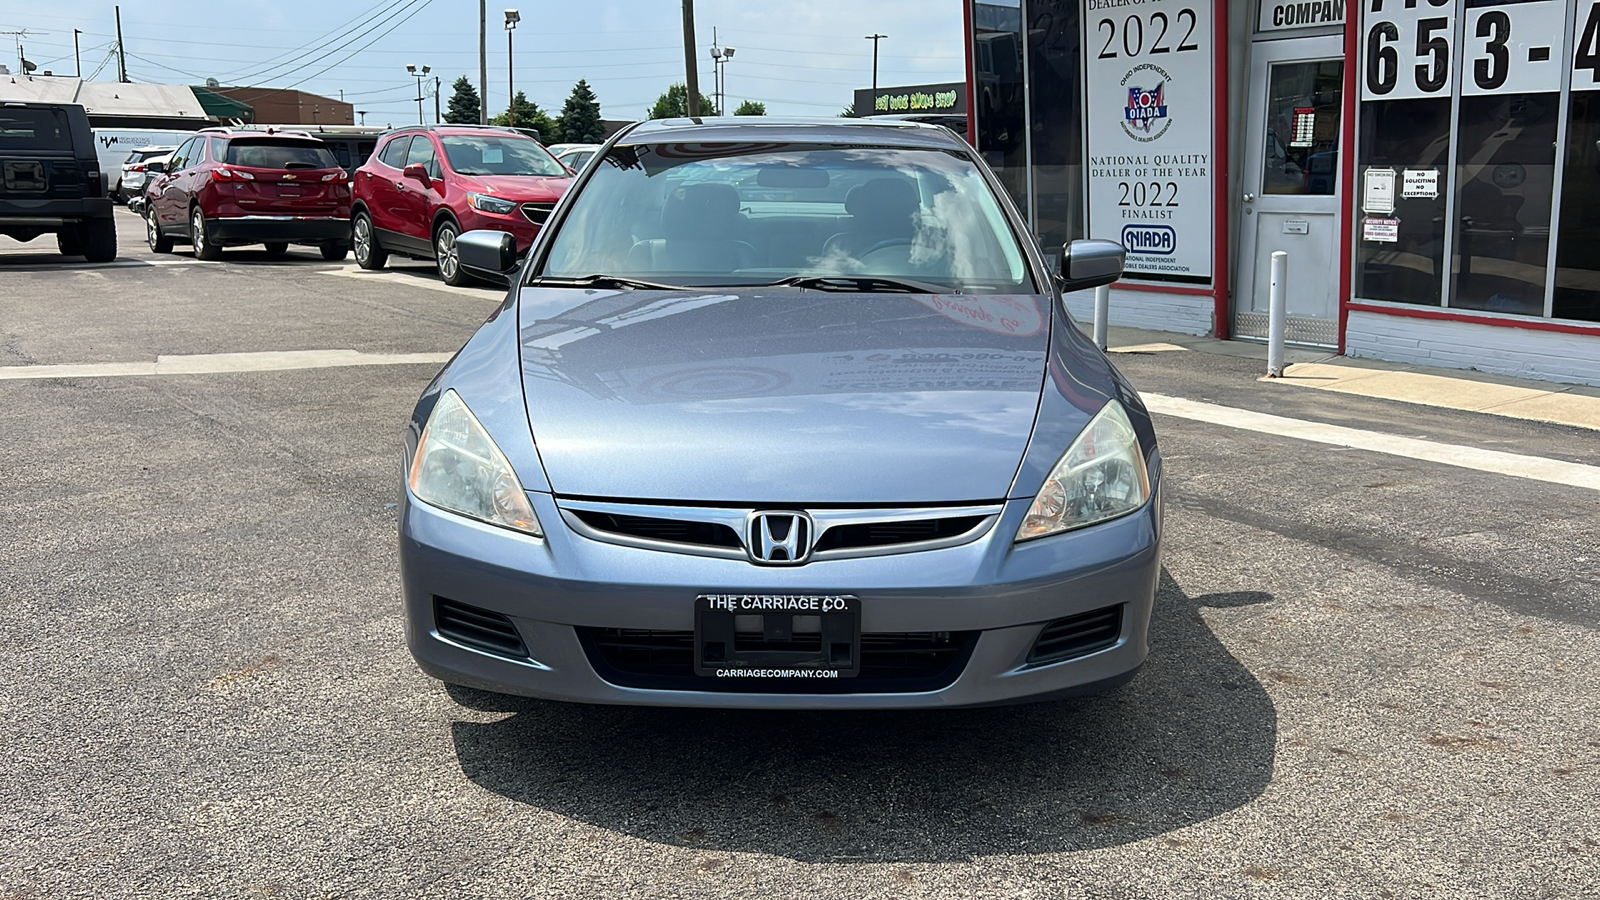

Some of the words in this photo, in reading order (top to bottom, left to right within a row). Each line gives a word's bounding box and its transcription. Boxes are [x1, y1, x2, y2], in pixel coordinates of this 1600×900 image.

[1098, 9, 1198, 59] 2022
[1120, 70, 1133, 86] OHIO
[1133, 64, 1172, 82] INDEPENDENT
[935, 90, 957, 109] SHOP
[1130, 107, 1160, 118] OIADA
[1091, 156, 1149, 165] NATIONAL
[1154, 155, 1208, 166] QUALITY
[1092, 169, 1131, 177] DEALER
[1135, 168, 1148, 177] OF
[1152, 168, 1173, 177] THE
[1178, 168, 1206, 177] YEAR
[1118, 182, 1179, 207] 2022
[1122, 209, 1173, 219] FINALIST
[1126, 231, 1170, 248] NIADA
[707, 596, 737, 609] THE
[741, 597, 819, 609] CARRIAGE
[823, 597, 848, 609] CO.
[716, 669, 838, 678] CARRIAGECOMPANY.COM
